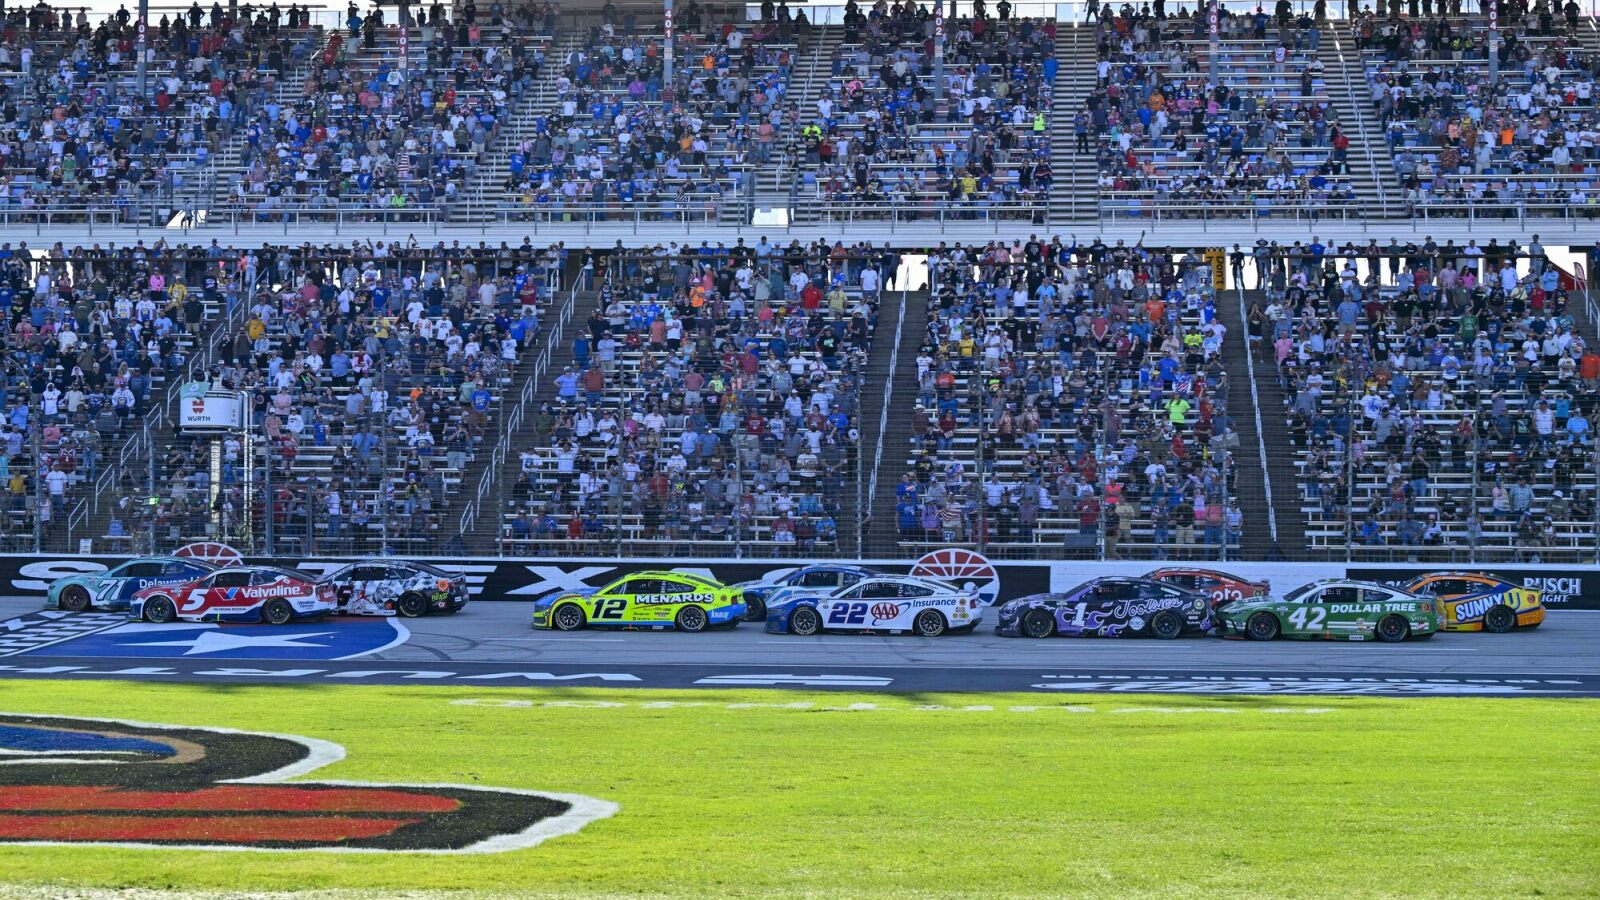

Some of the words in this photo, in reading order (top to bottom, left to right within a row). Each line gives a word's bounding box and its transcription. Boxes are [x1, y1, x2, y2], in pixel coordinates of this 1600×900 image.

[1489, 1, 1497, 30] 404
[399, 27, 407, 55] 101
[96, 579, 128, 601] 71
[181, 588, 210, 611] 5
[635, 593, 714, 604] MENARDS
[1541, 594, 1569, 602] IGHT
[592, 598, 628, 619] 12
[828, 602, 869, 624] 22
[873, 603, 897, 619] AAA
[912, 598, 957, 608] Insurance
[1071, 602, 1088, 626] 1
[1331, 603, 1380, 614] DOLLAR
[1385, 602, 1416, 612] TREE
[1288, 607, 1326, 629] 42
